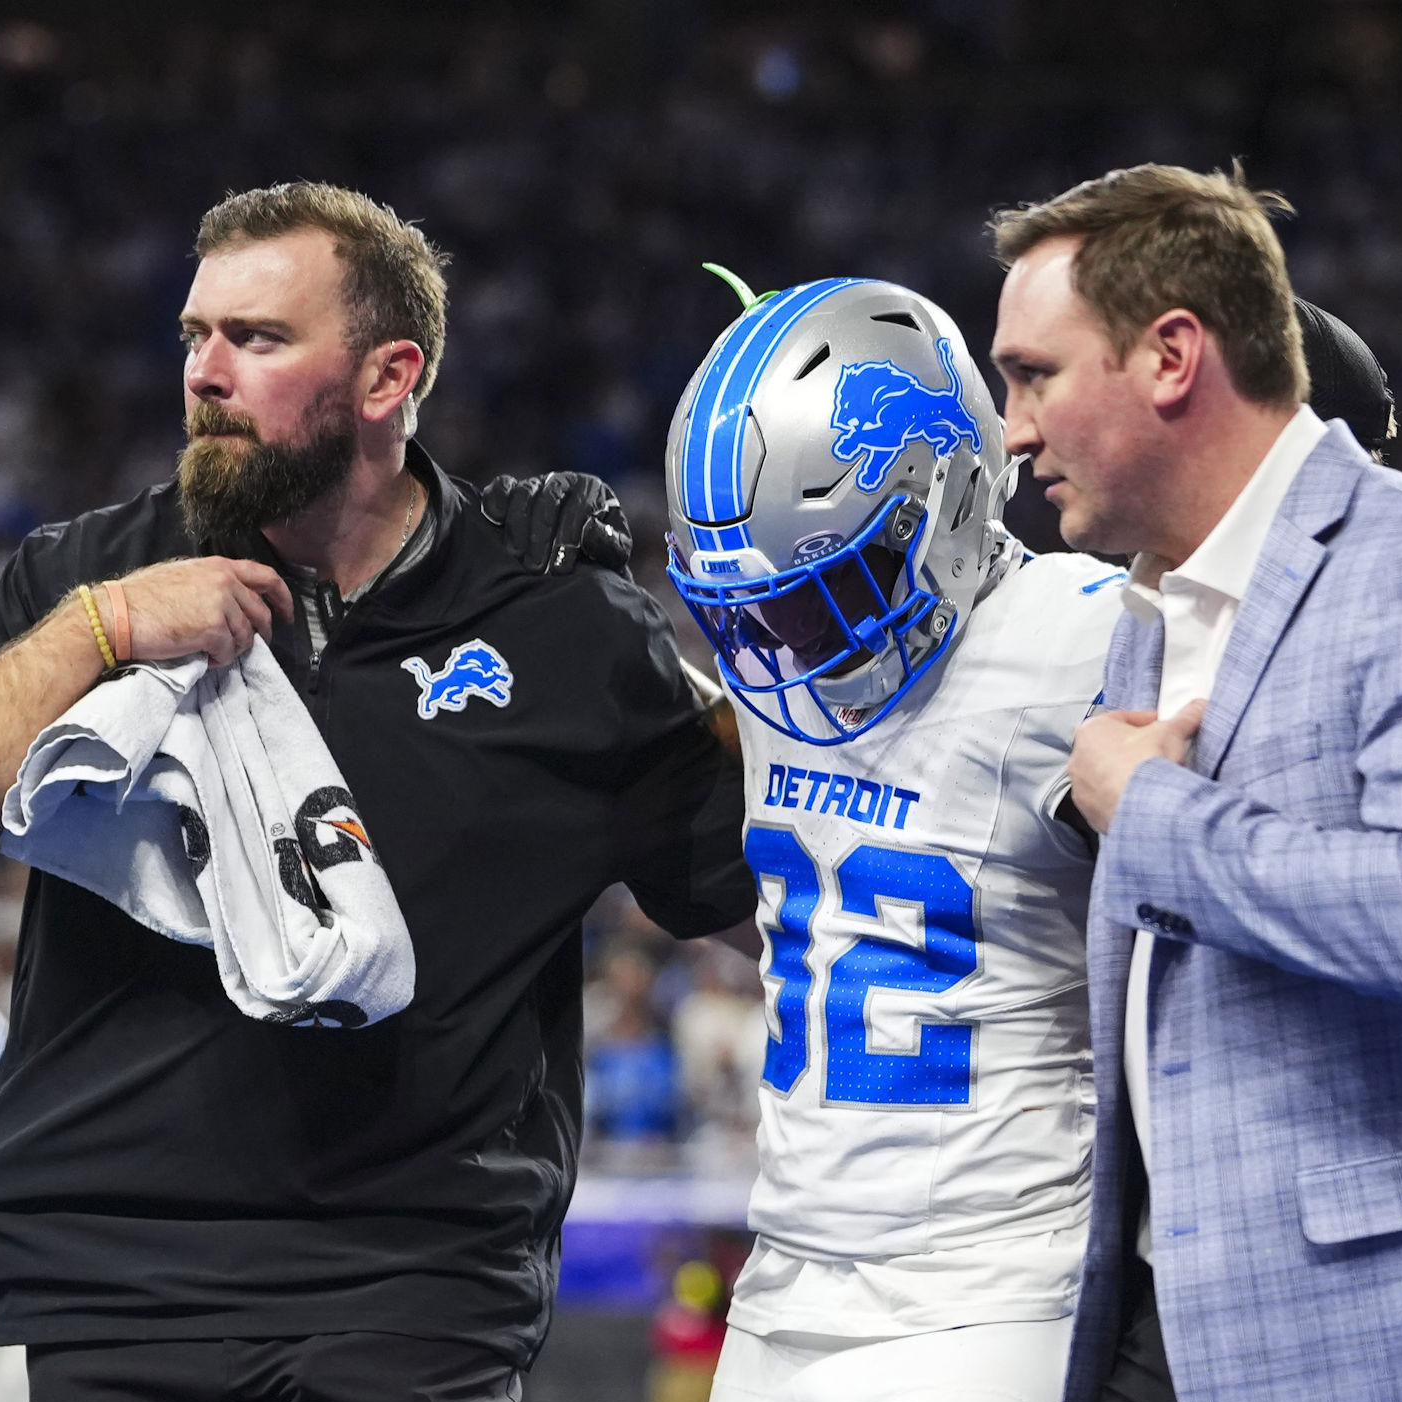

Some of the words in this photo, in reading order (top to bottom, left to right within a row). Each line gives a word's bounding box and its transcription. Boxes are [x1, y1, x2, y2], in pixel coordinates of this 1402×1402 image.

[794, 541, 842, 565] OAKLEY
[838, 707, 860, 722] NFL
[764, 763, 920, 829] DETROIT
